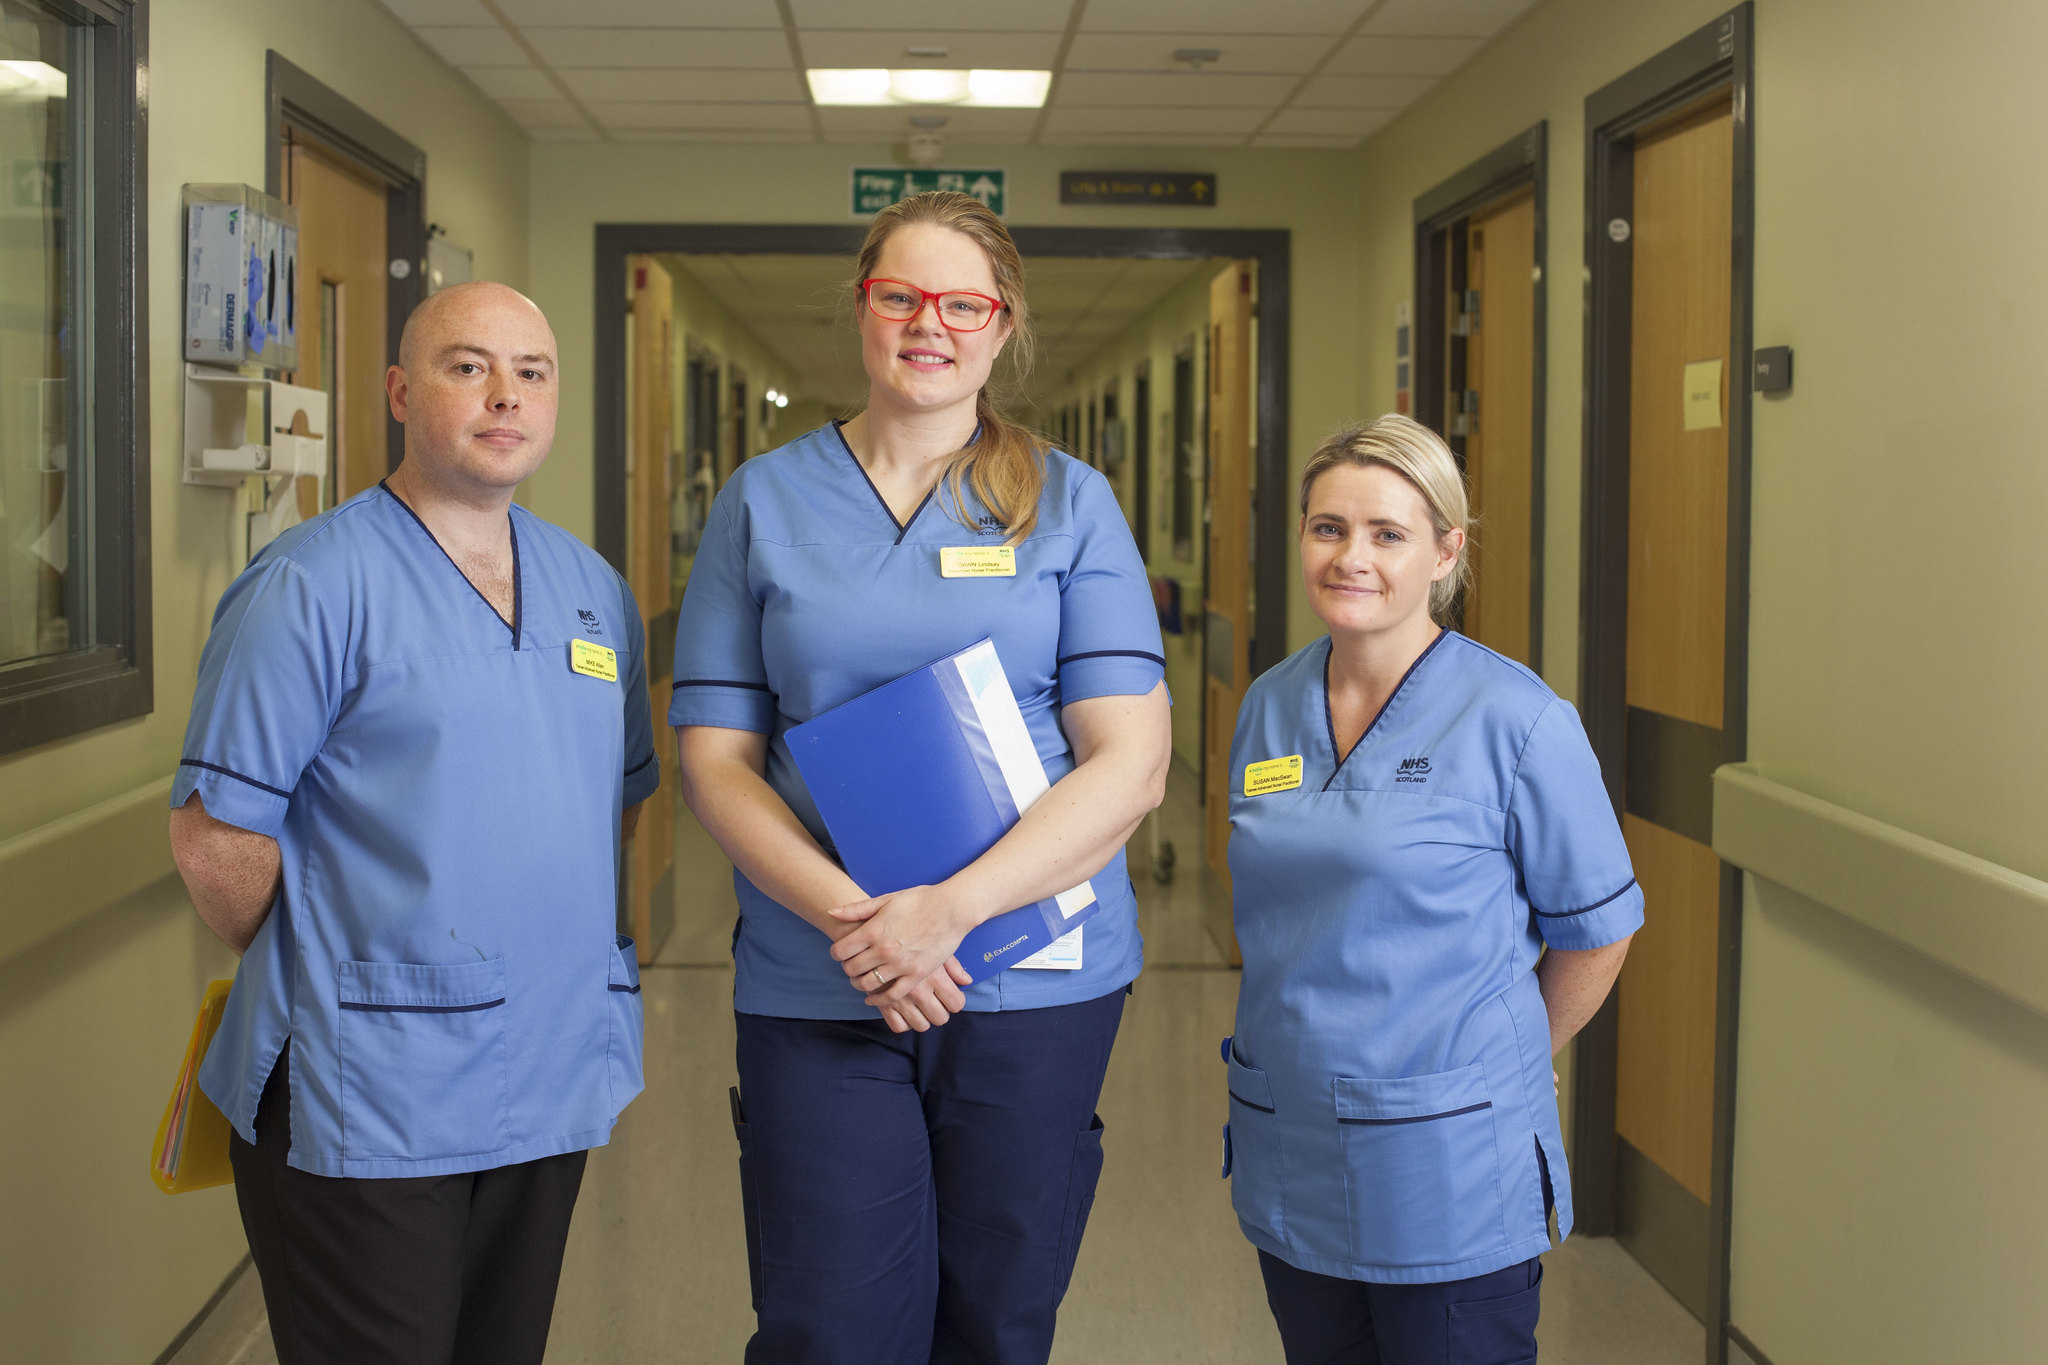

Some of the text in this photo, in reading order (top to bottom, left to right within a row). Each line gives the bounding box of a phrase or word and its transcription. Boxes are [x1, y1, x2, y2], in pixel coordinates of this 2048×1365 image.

[226, 293, 235, 352] DERMAGRIP
[577, 609, 595, 621] NHS
[1400, 757, 1429, 770] NHS
[1253, 774, 1292, 786] SUSAN MacSwan
[993, 934, 1029, 957] EXACOMPTA
